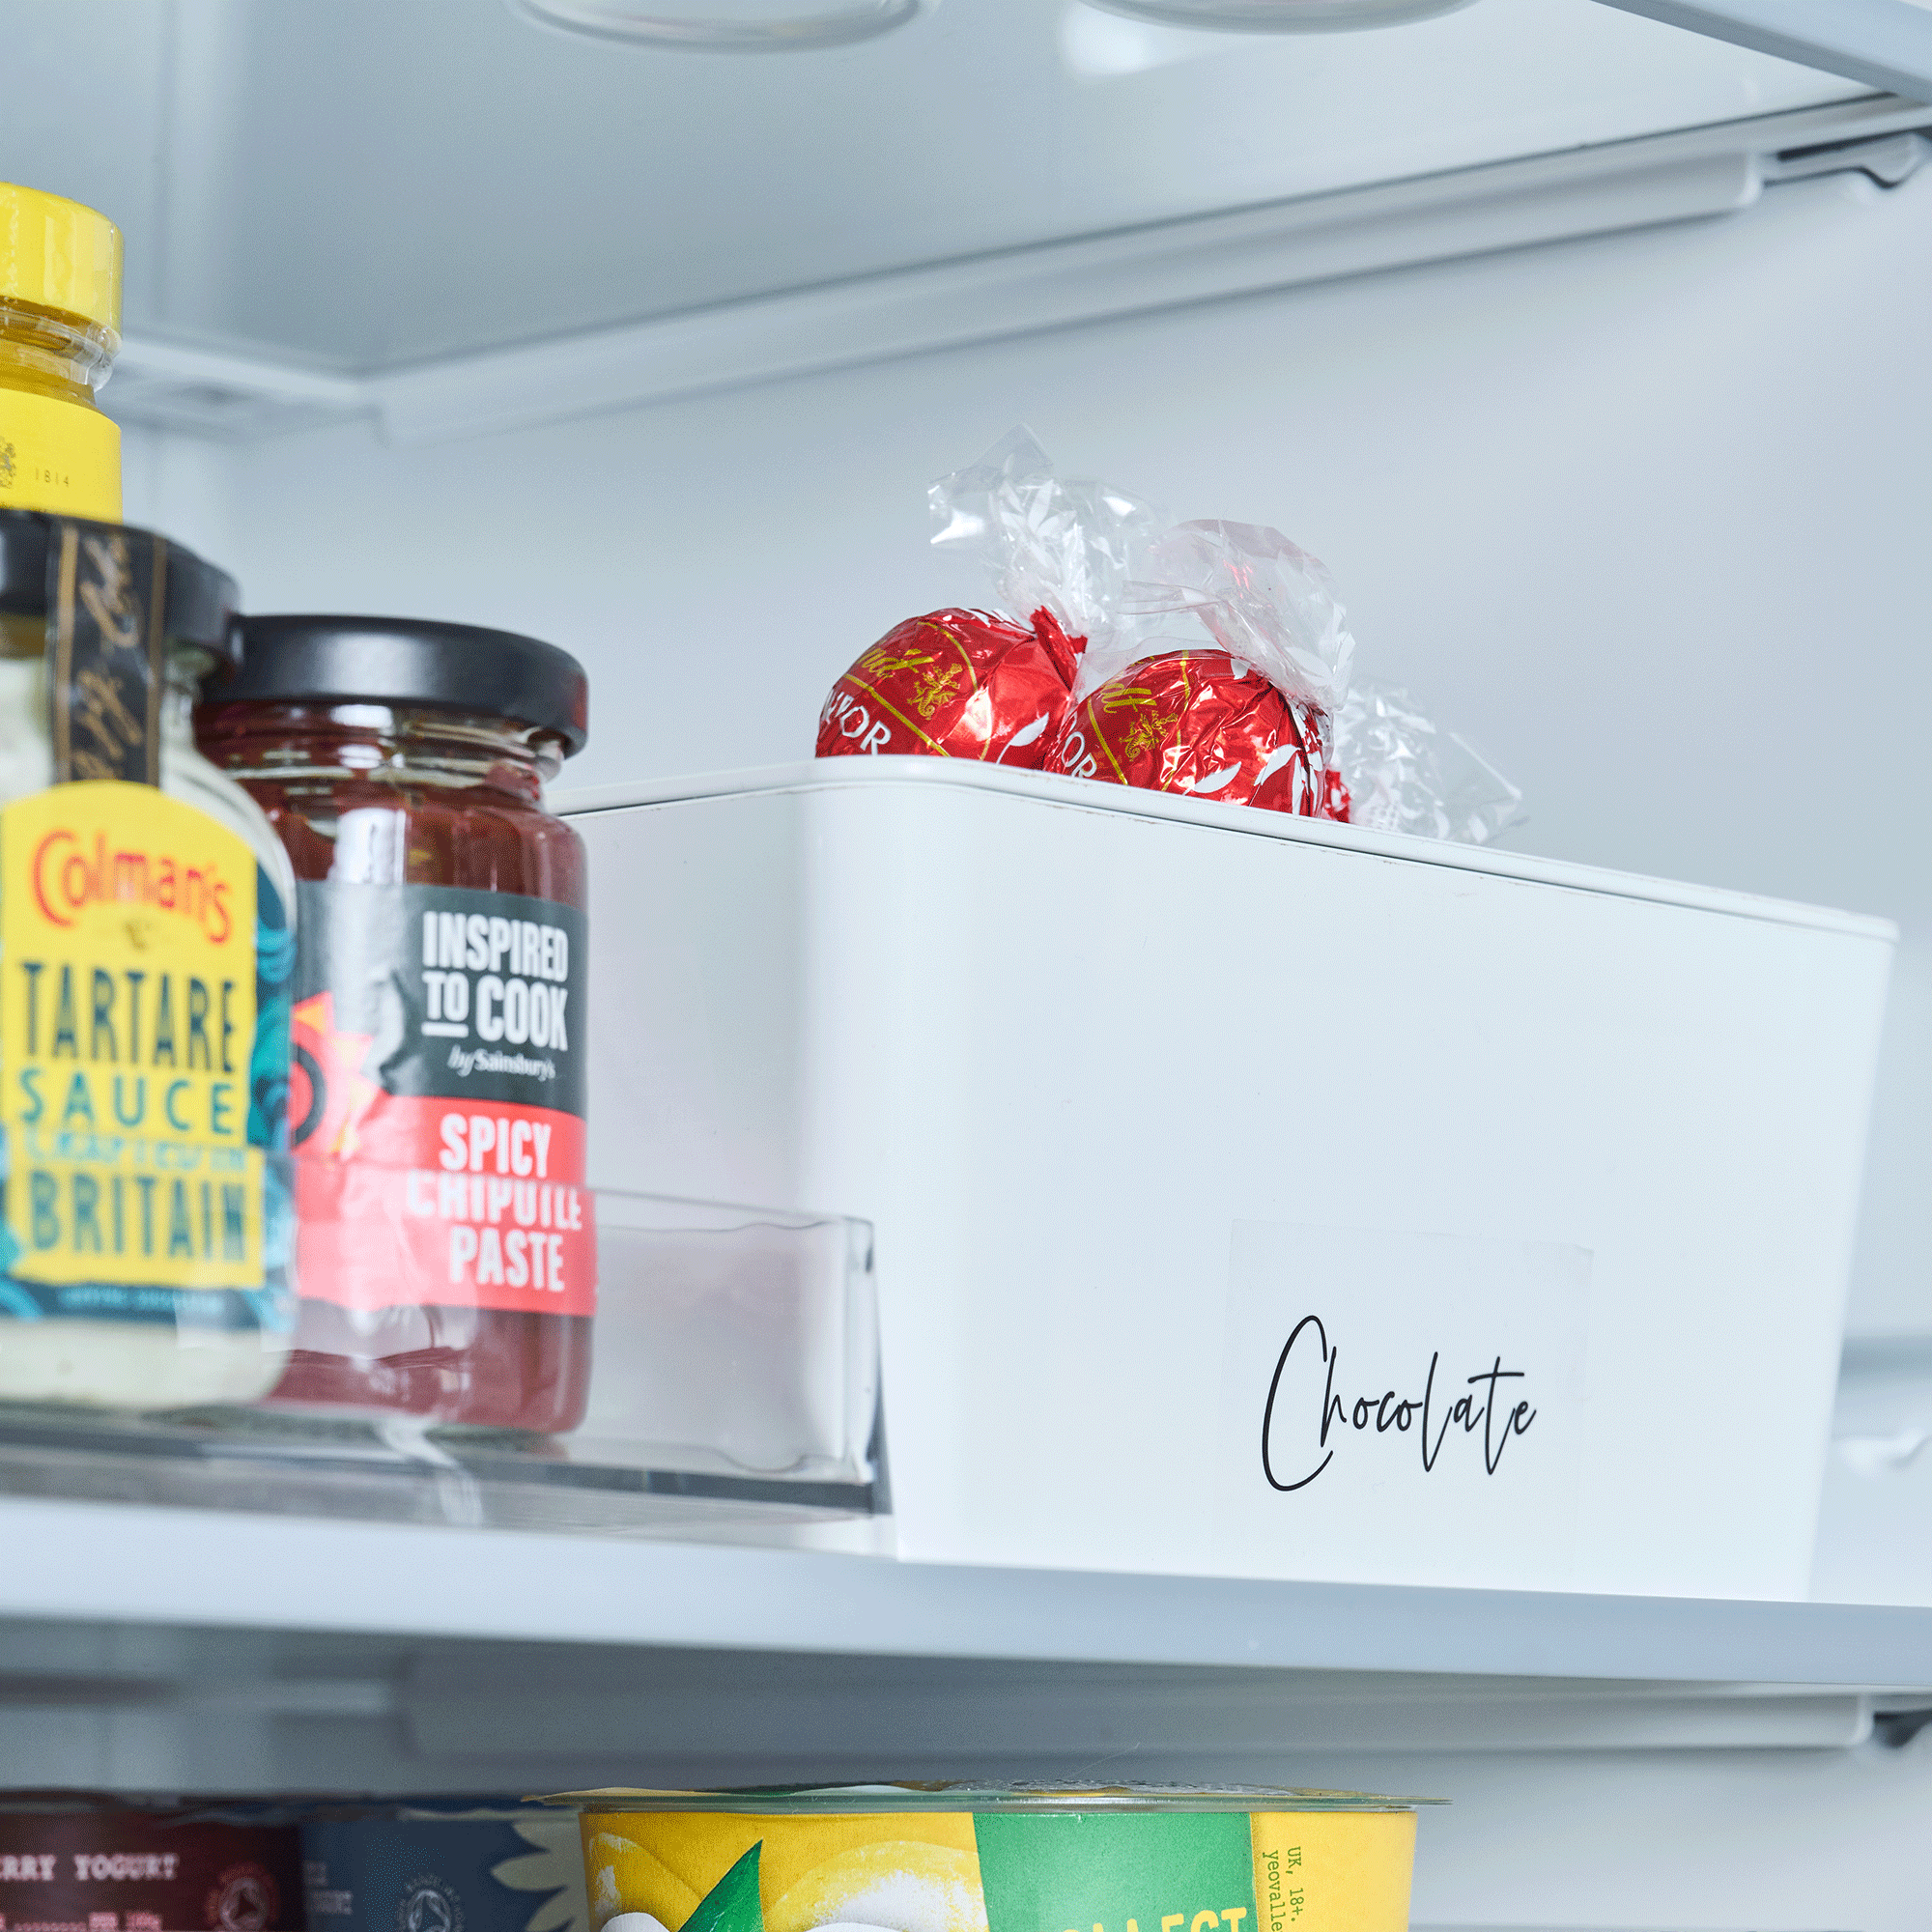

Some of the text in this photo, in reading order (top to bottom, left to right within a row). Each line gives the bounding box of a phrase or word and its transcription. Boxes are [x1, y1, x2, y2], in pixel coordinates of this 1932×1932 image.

[35, 468, 70, 488] 1814
[31, 829, 232, 944] Colman's
[423, 911, 568, 981] INSPIRED
[21, 961, 235, 1074] TARTARE
[422, 971, 568, 1051] TO COOK
[447, 1044, 475, 1077] by
[20, 1067, 234, 1136] SAUCE
[440, 1113, 552, 1179] SPICY
[31, 1169, 244, 1263] BRITAIN
[449, 1226, 564, 1292] PASTE
[1262, 1315, 1537, 1492] Chocolate
[0, 1854, 55, 1881] RRY
[1262, 1850, 1286, 1932] yeovalle
[1285, 1846, 1305, 1922] UK, 18+.
